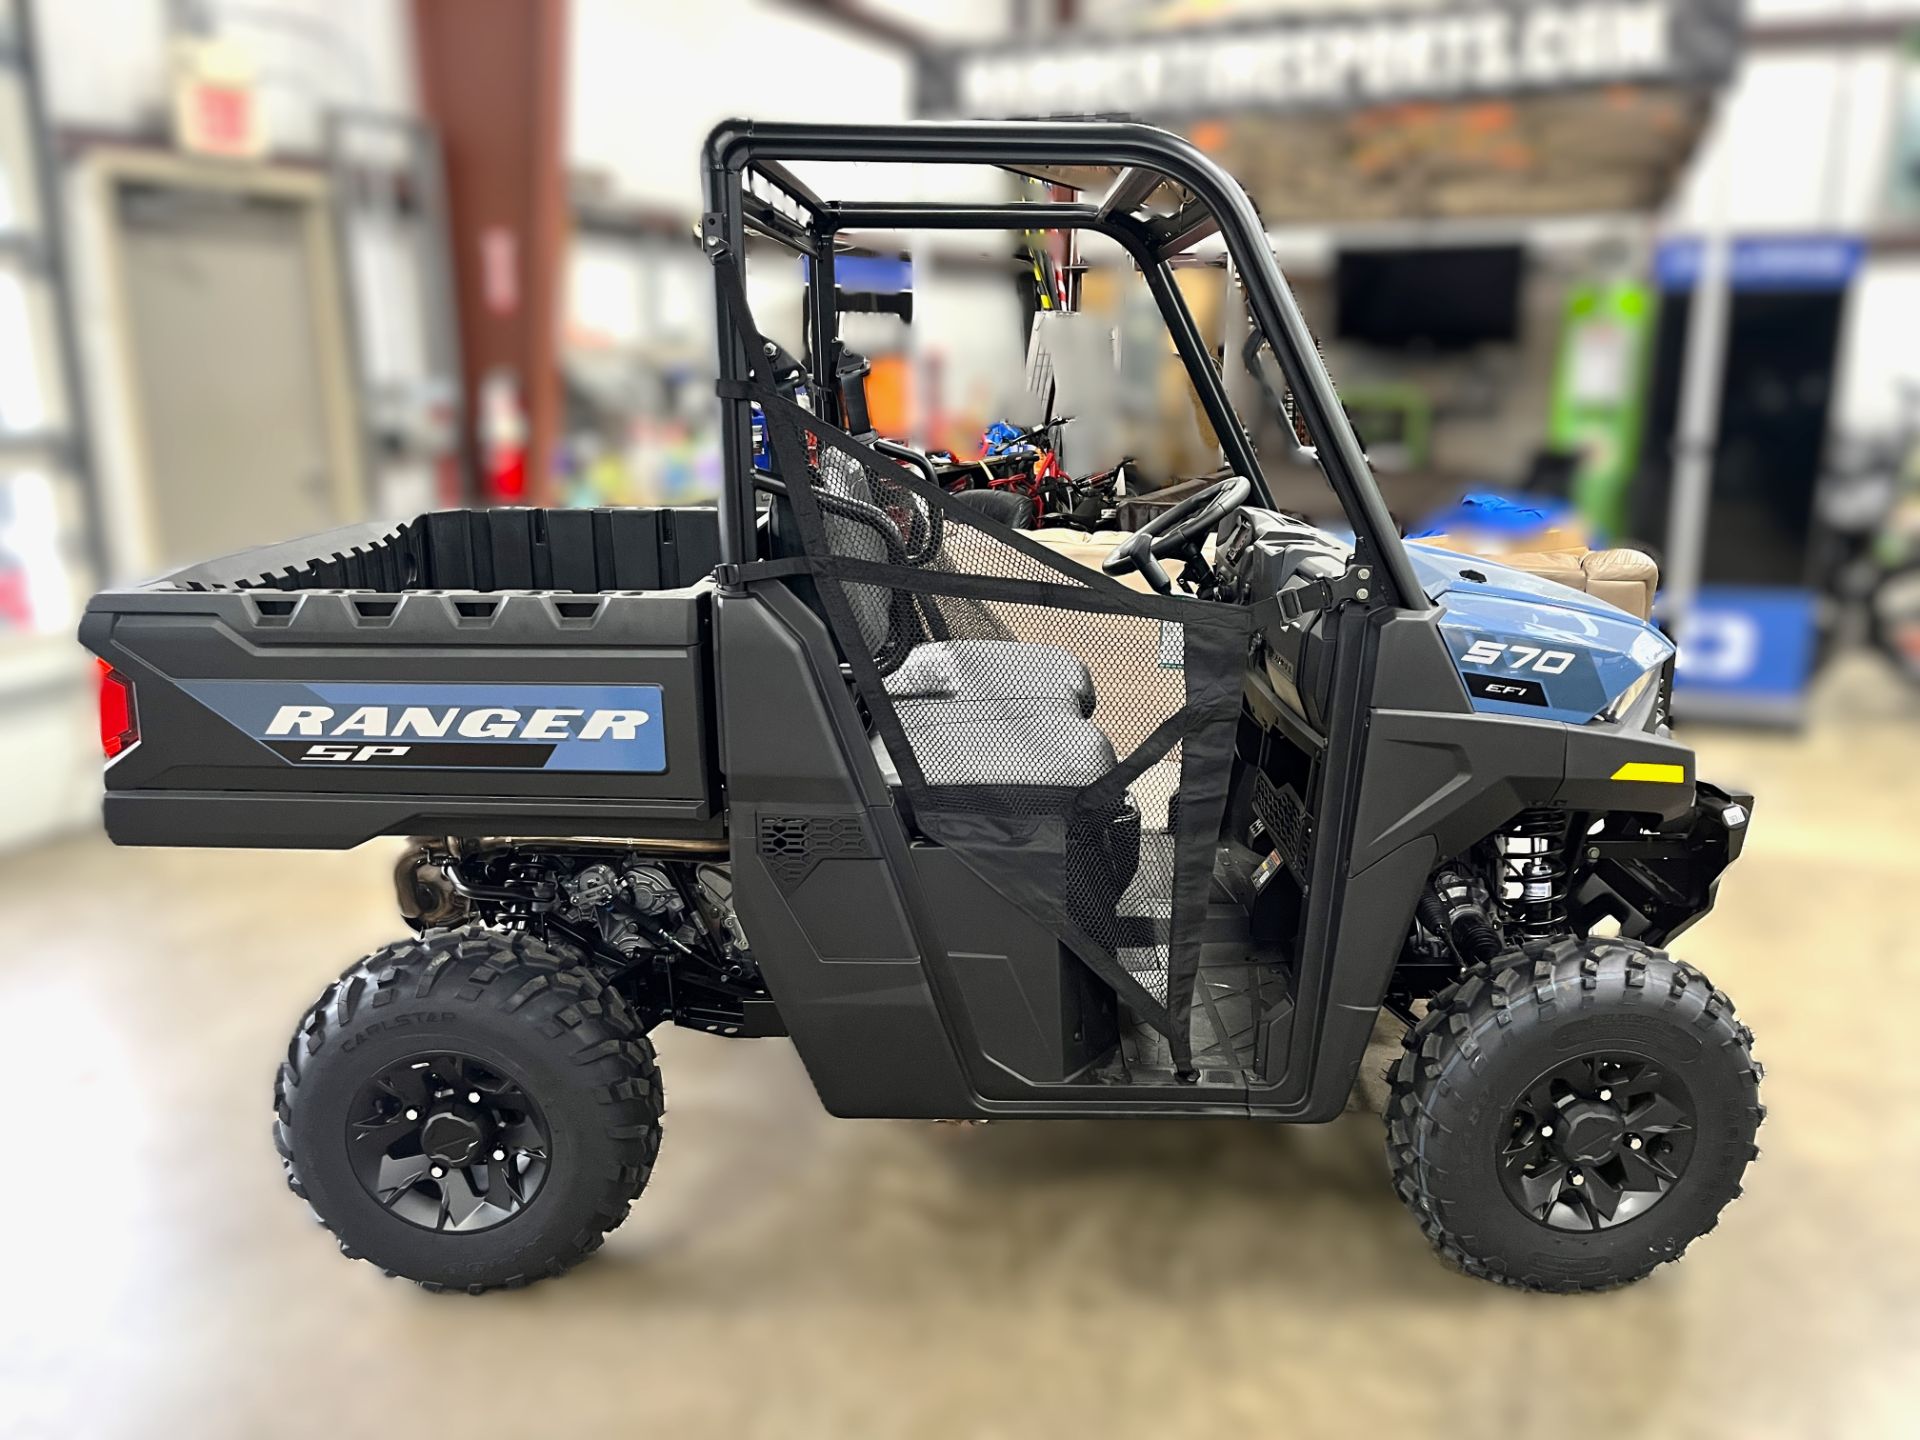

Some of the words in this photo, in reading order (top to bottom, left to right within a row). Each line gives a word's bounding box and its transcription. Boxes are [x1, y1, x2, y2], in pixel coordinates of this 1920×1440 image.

[1461, 640, 1576, 674] 570
[1485, 683, 1527, 696] EFI
[265, 705, 650, 740] RANGER
[301, 744, 412, 762] SP
[341, 1011, 457, 1054] CARLSTAR
